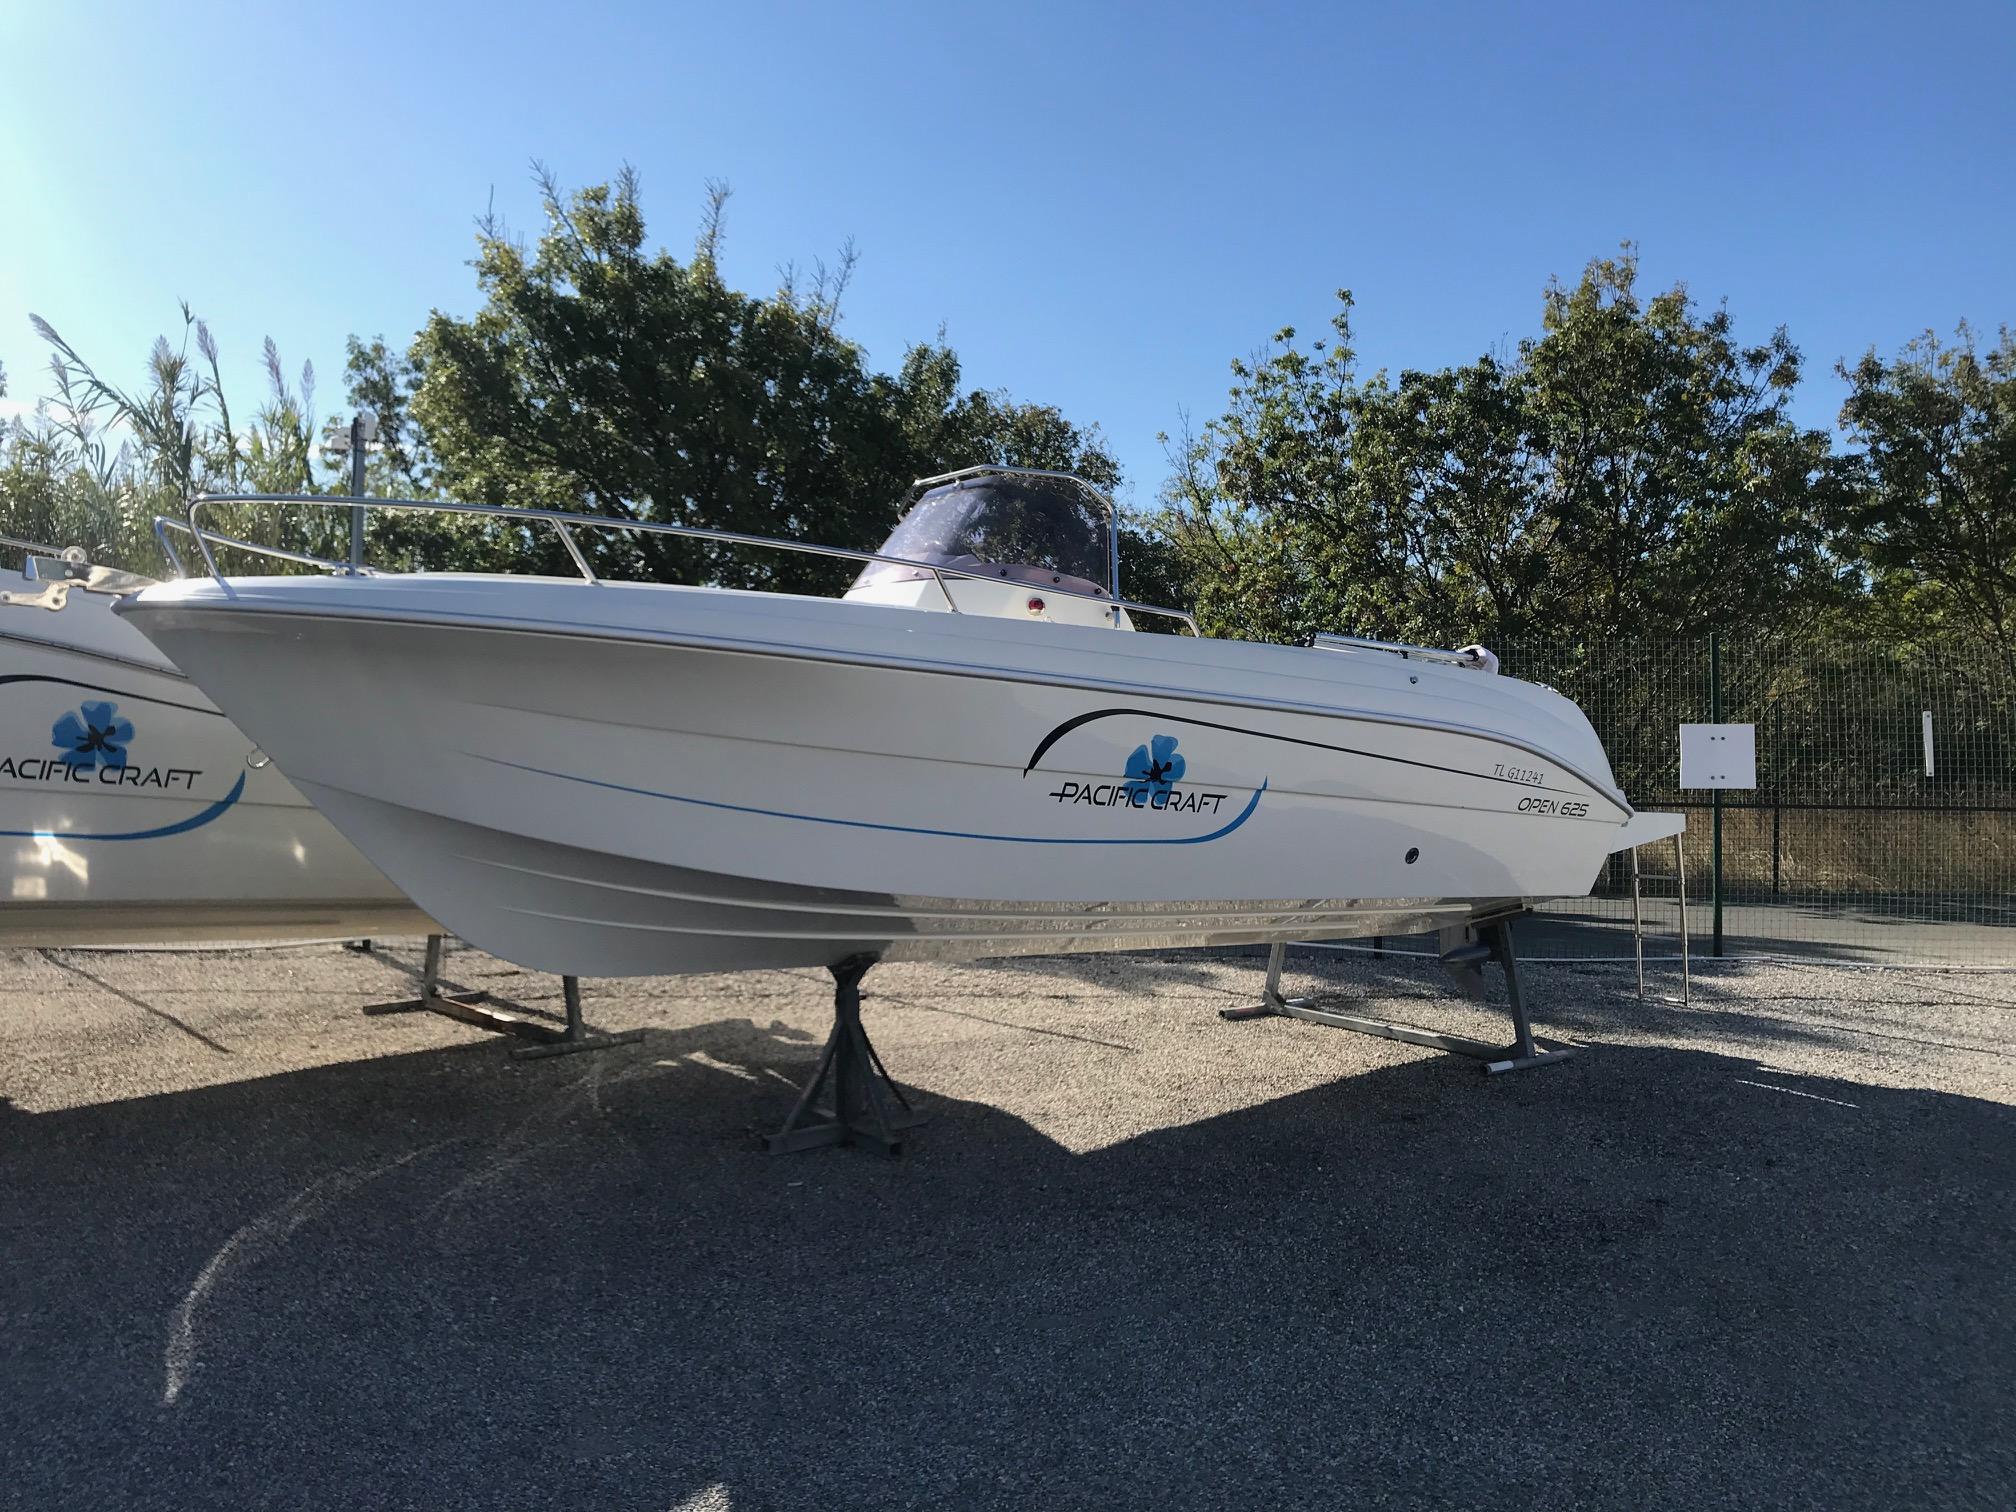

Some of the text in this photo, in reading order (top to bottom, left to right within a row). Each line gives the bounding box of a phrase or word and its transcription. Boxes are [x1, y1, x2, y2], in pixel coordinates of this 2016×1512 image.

[0, 757, 203, 789] ACIFIC CRAFT
[1494, 764, 1505, 777] TL
[1049, 782, 1228, 814] PACIFIC CRAFT
[1518, 797, 1590, 817] OPEN 625
